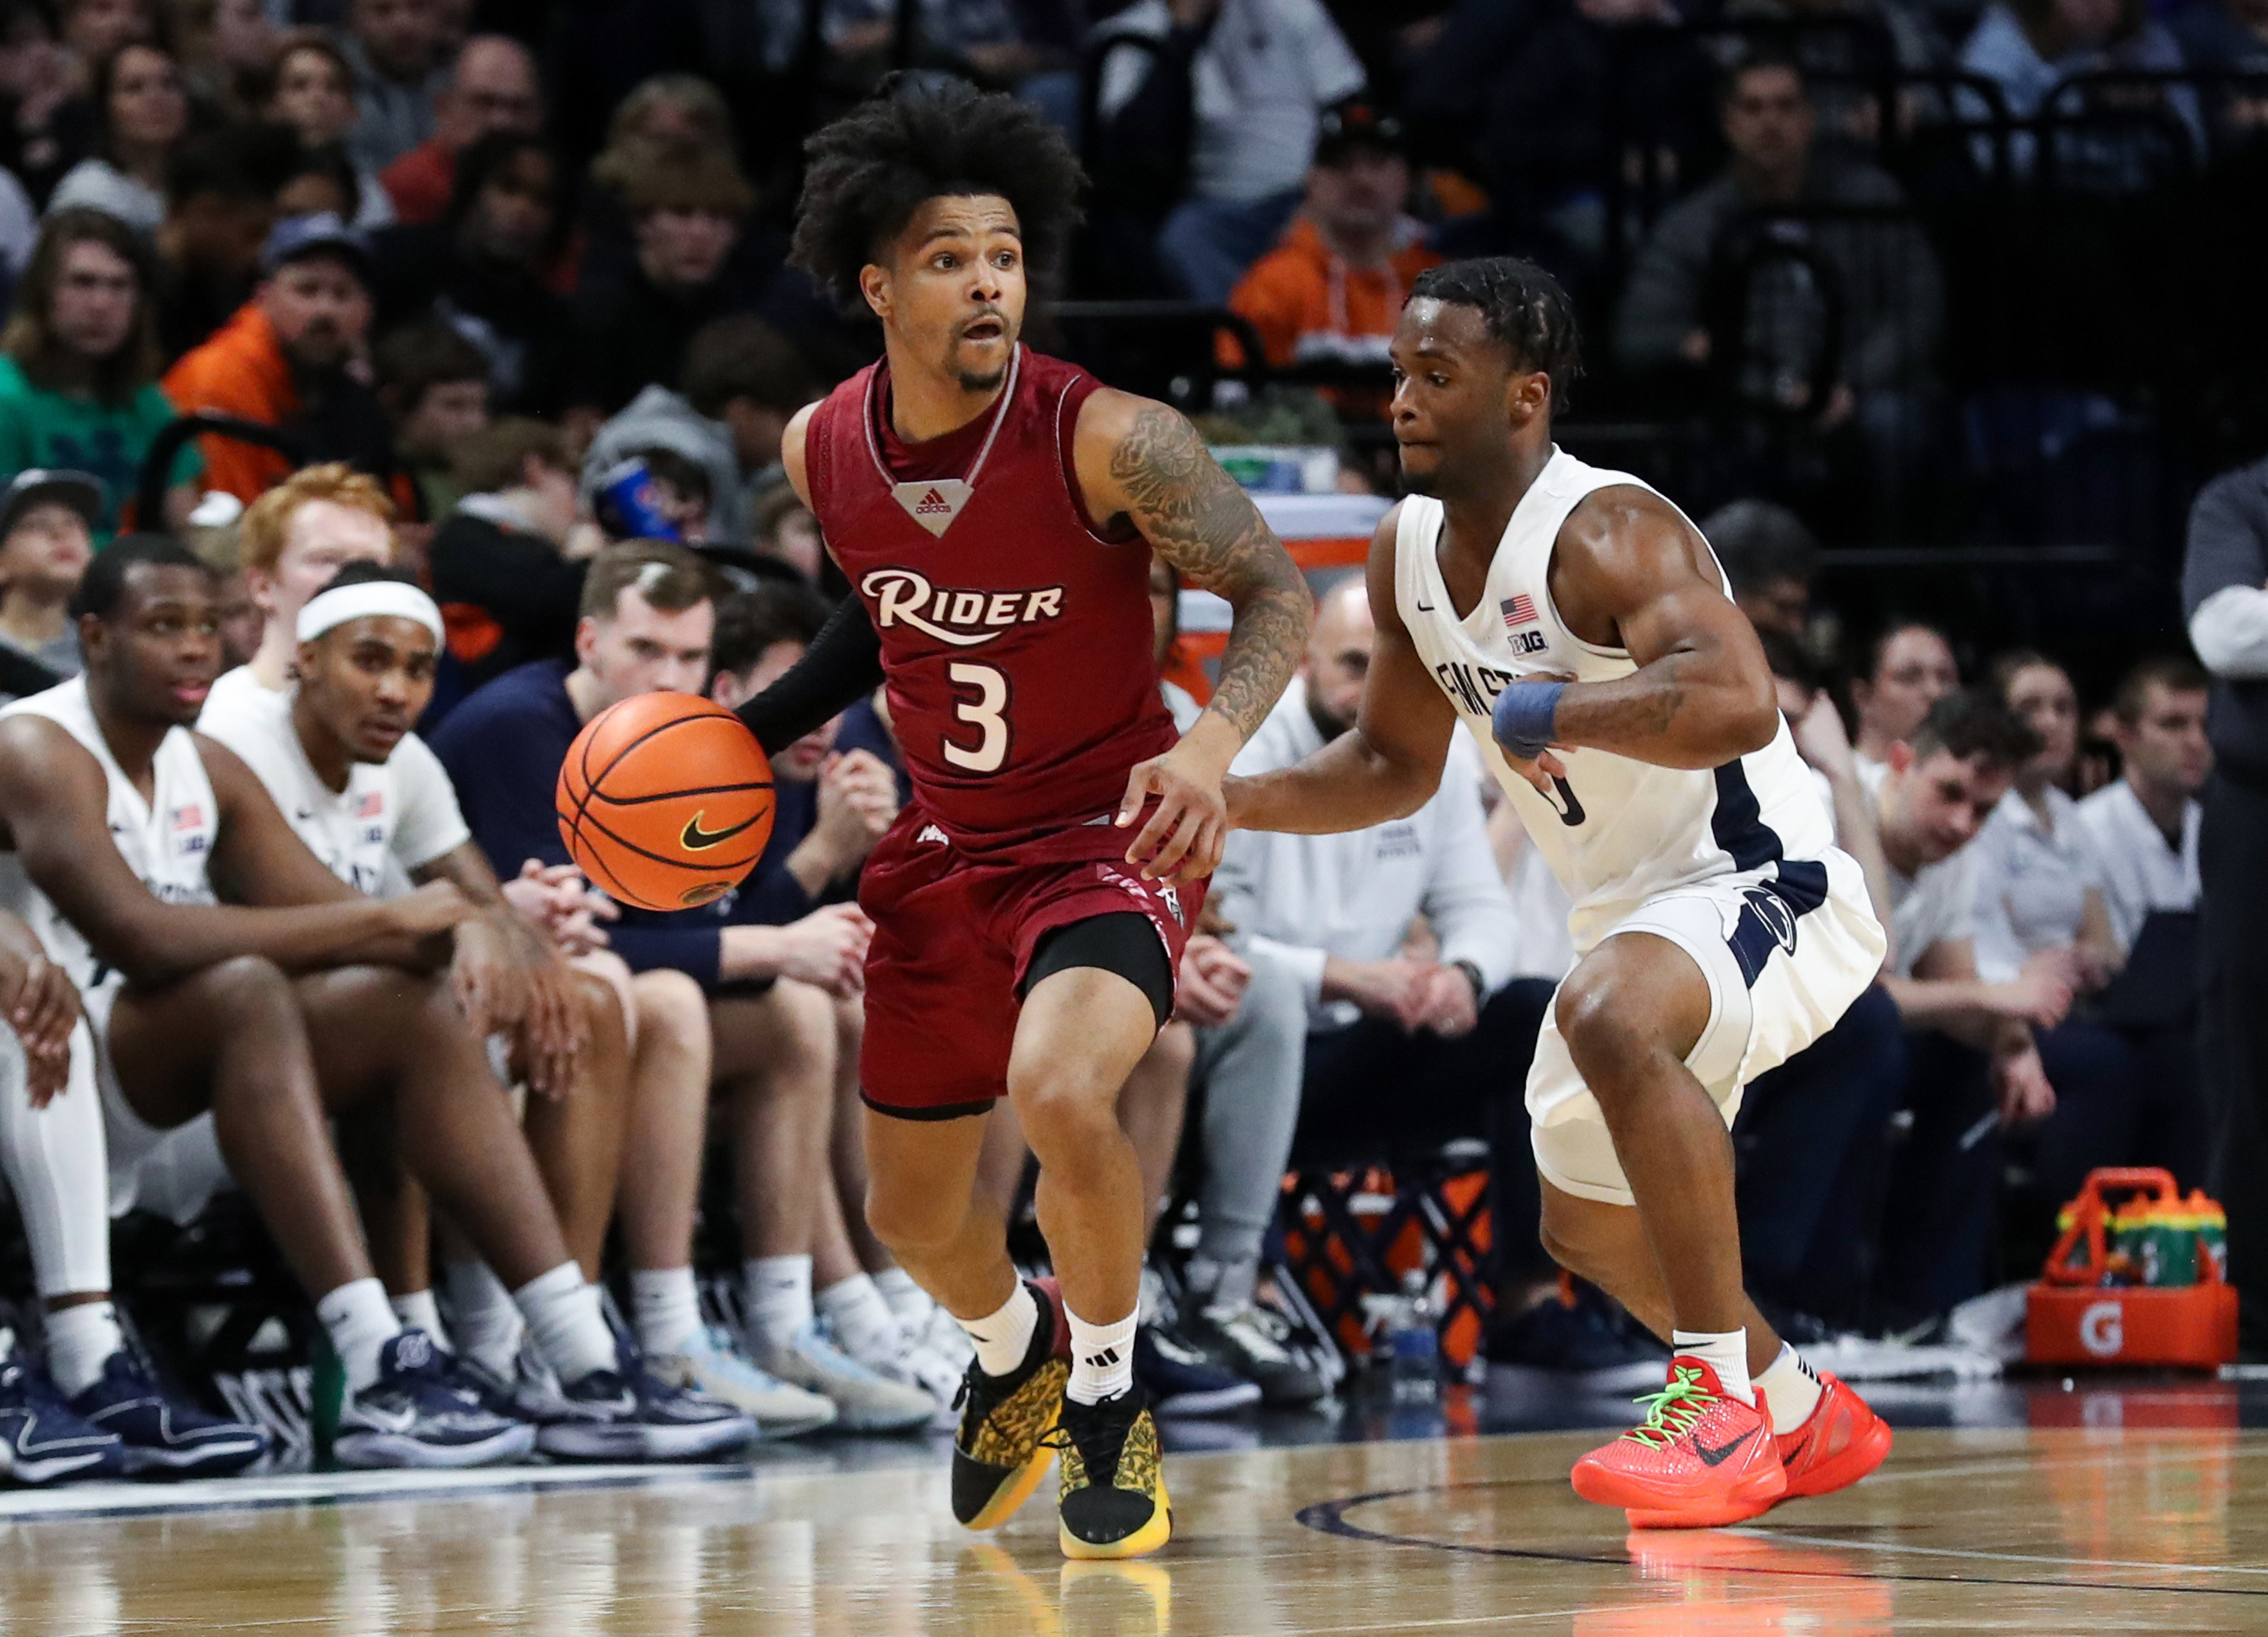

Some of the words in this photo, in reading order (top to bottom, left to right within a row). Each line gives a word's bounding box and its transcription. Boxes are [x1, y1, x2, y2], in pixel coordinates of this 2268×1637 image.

[915, 504, 952, 514] adidas
[943, 662, 1009, 773] 3
[2080, 1300, 2124, 1357] G
